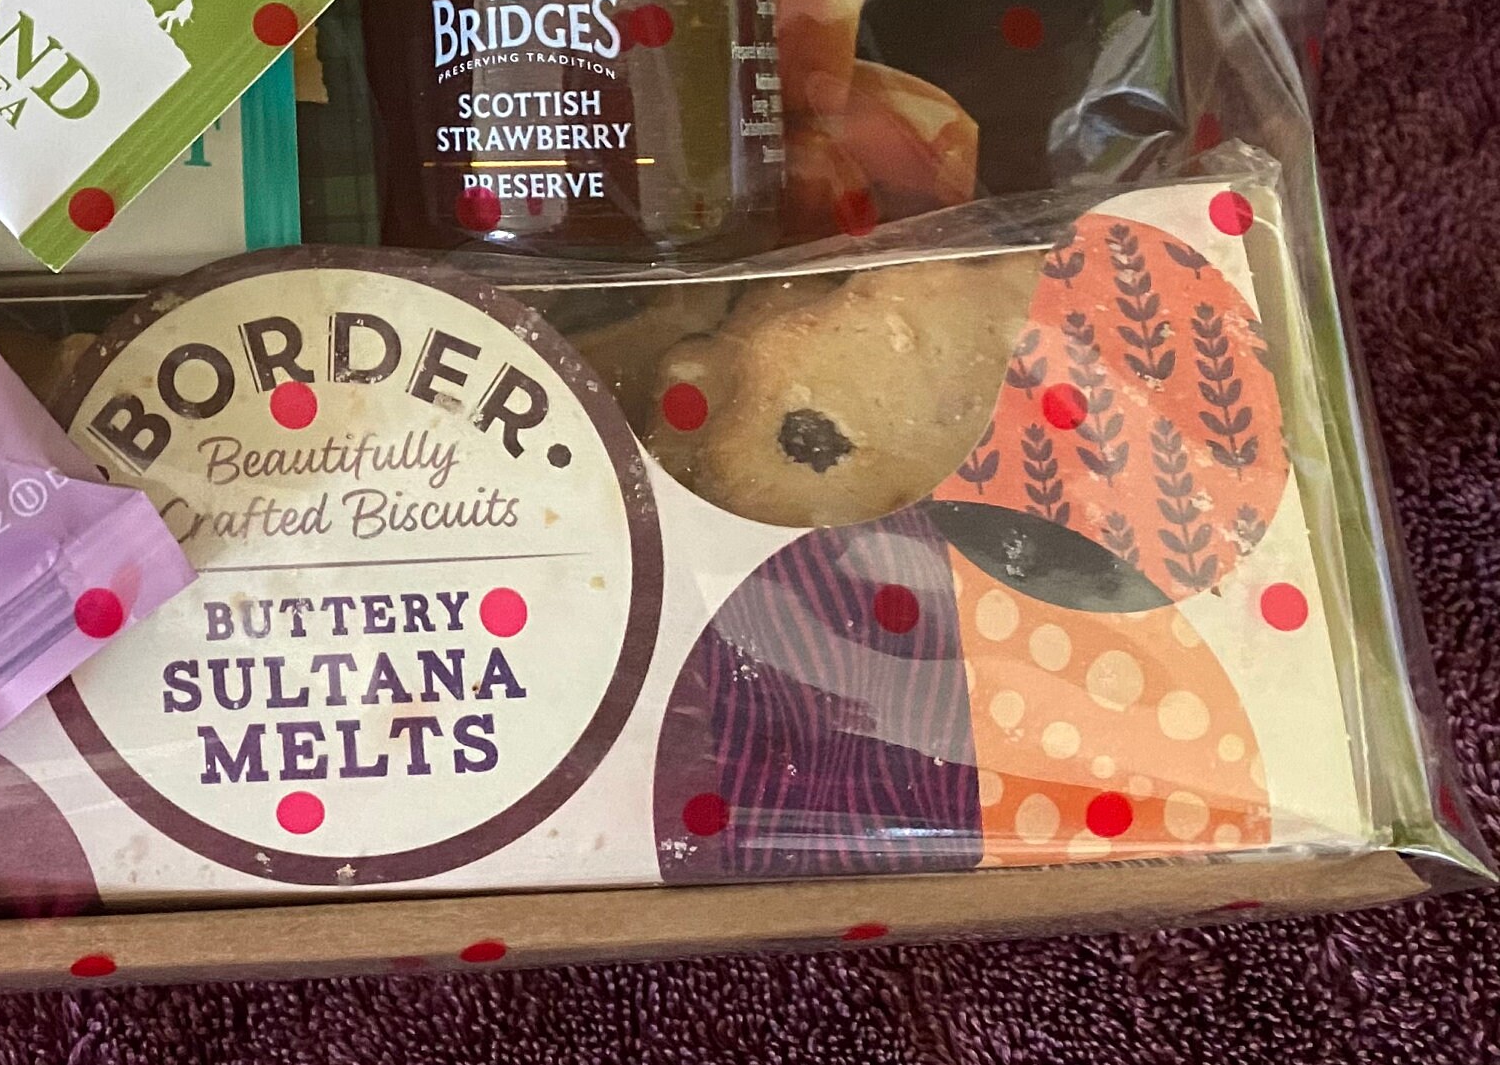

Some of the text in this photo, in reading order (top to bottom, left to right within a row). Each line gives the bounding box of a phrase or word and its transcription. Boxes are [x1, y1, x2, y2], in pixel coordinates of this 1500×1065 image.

[438, 52, 617, 84] PRESERVING TRADITION
[457, 90, 601, 119] SCOTTISH
[436, 122, 632, 152] STRAWBERRY
[462, 172, 605, 199] PRESERVE
[197, 429, 460, 488] Beautifully
[159, 486, 521, 545] Crafted Biscuits
[203, 591, 470, 641] BUTTERY
[162, 646, 528, 713] SULTANA
[197, 713, 500, 784] MELTS
